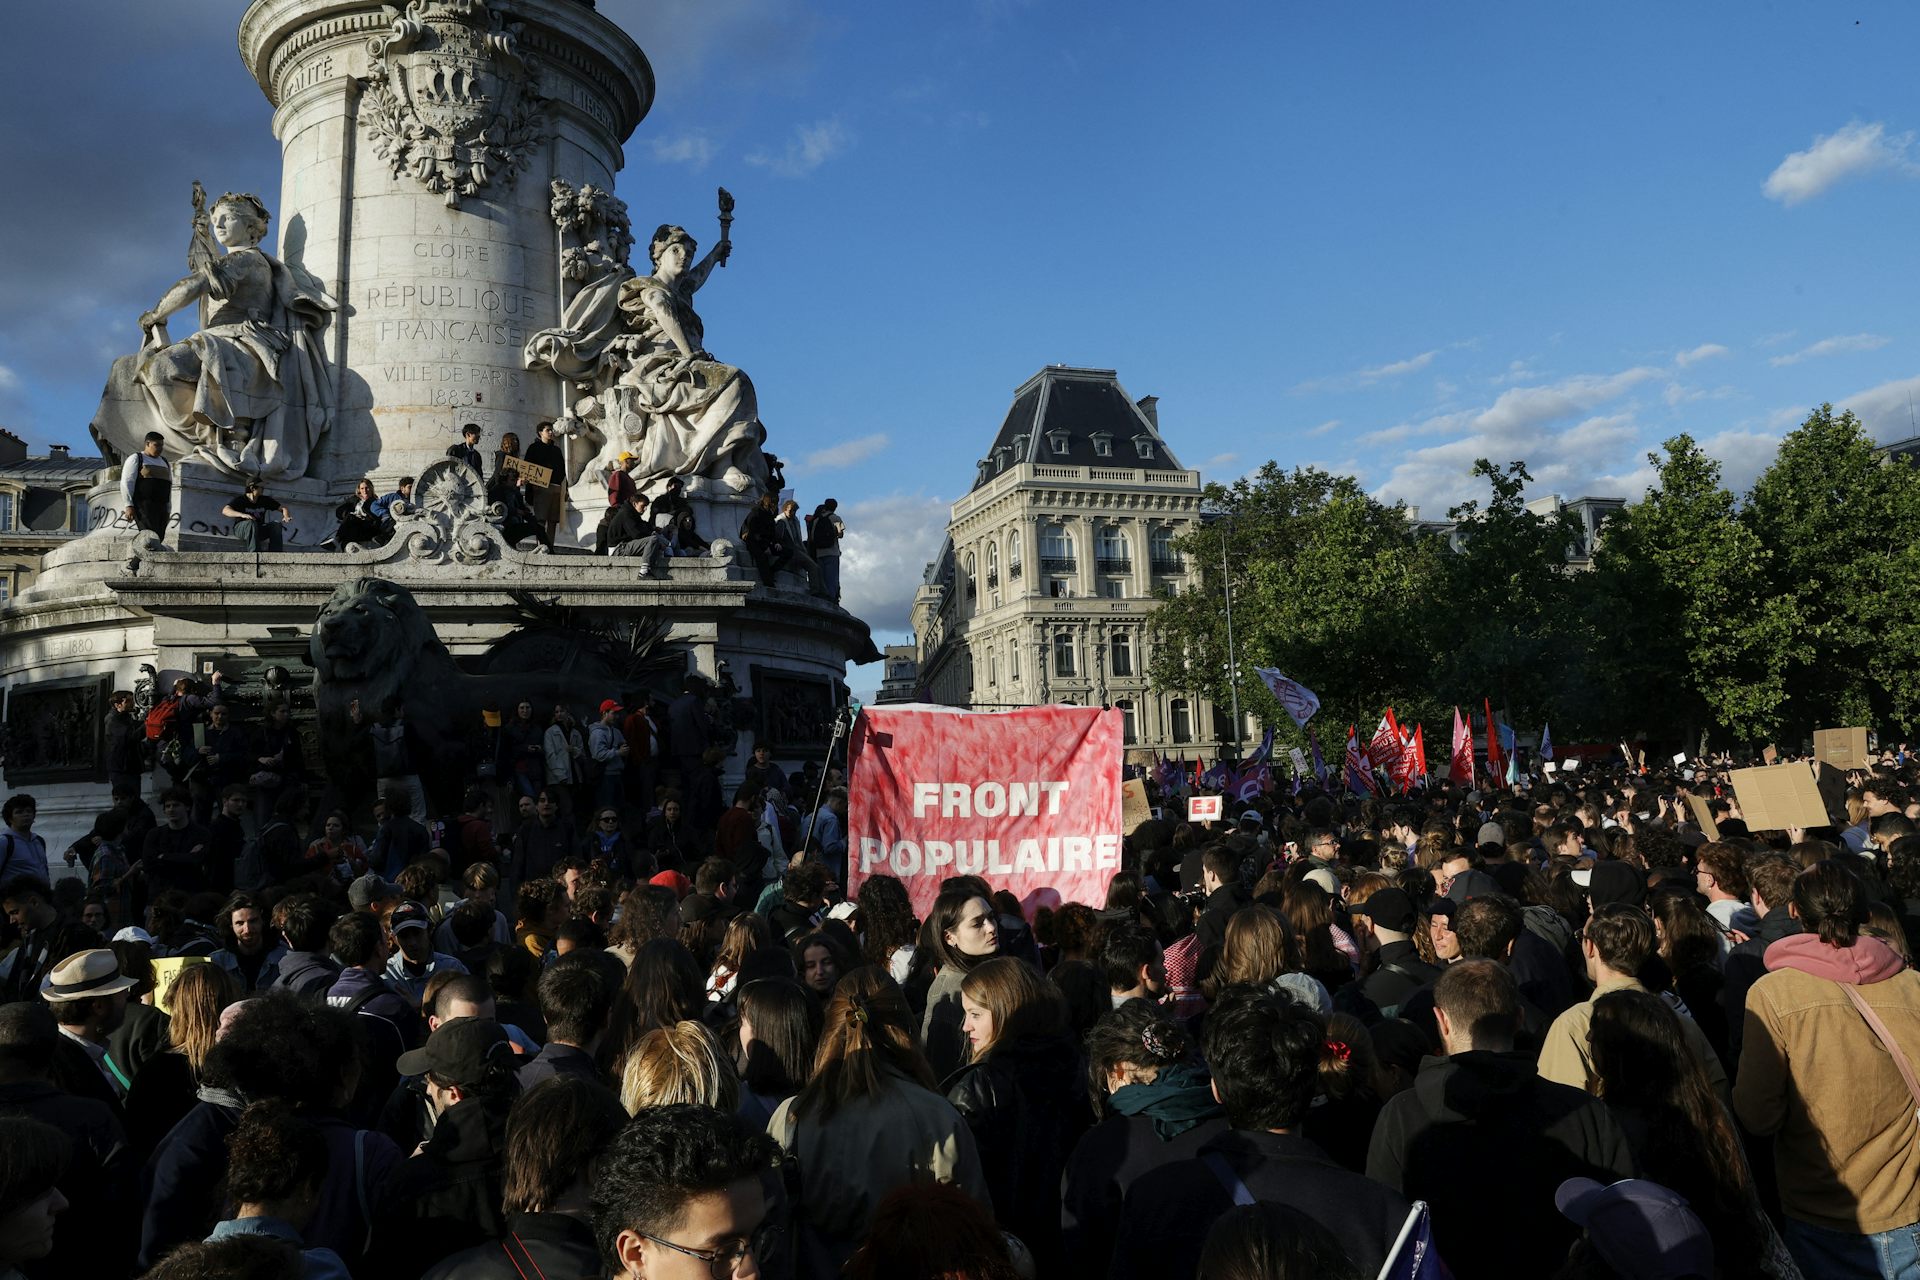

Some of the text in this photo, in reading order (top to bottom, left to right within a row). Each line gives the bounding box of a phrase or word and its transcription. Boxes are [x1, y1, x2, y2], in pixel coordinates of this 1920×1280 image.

[413, 242, 489, 262] GLOIRE
[367, 282, 535, 319] RÉPUBLIQUE
[381, 321, 522, 348] FRANÇAISE
[441, 349, 461, 360] LA
[383, 367, 520, 388] VILLE DE PARIS
[430, 389, 474, 406] 1883
[459, 410, 493, 422] FREE
[507, 458, 519, 471] RN
[528, 465, 544, 478] FN
[913, 781, 1069, 818] FRONT
[859, 835, 1118, 877] POPULAIRE
